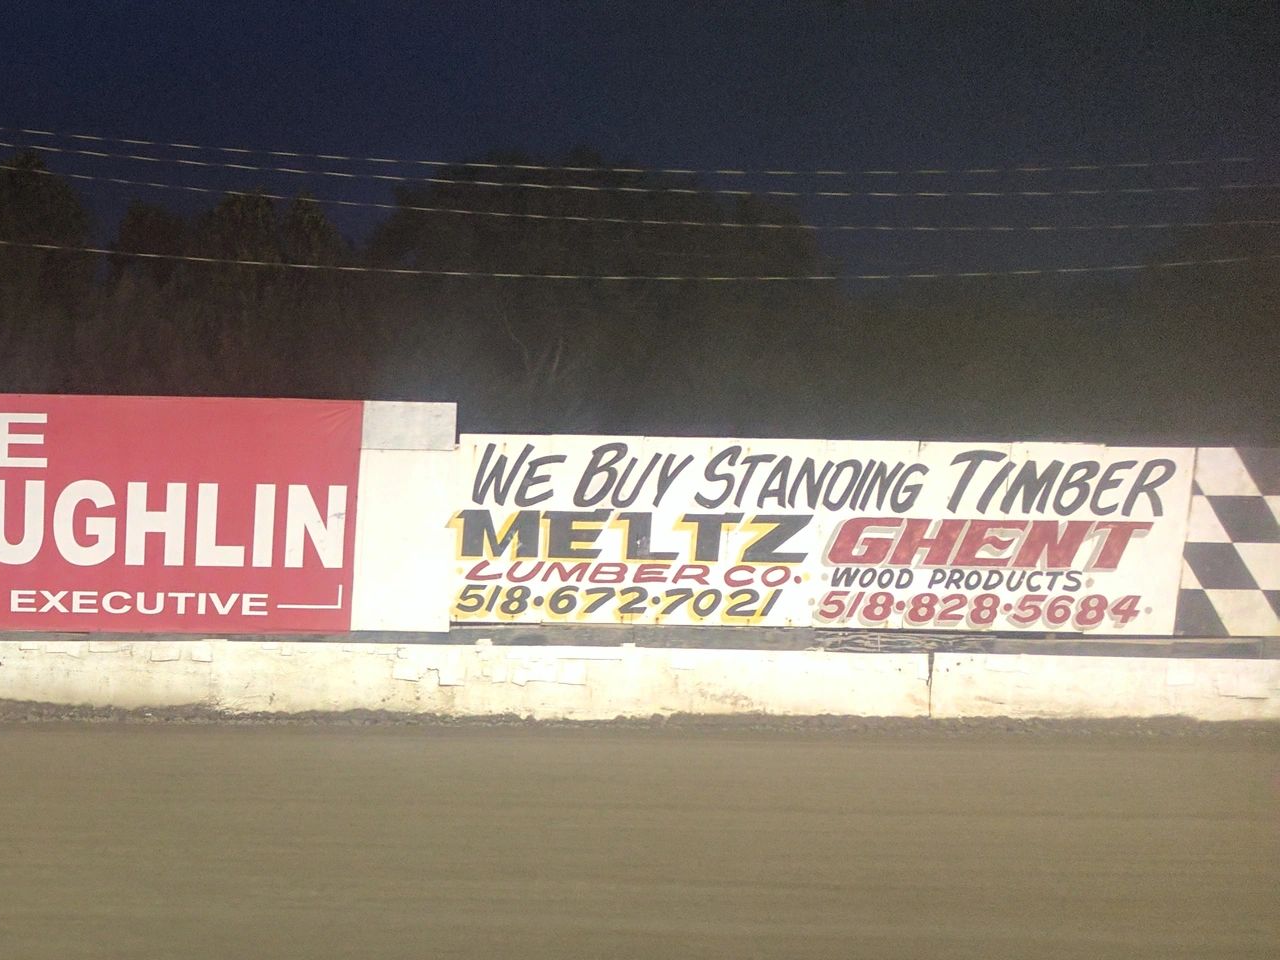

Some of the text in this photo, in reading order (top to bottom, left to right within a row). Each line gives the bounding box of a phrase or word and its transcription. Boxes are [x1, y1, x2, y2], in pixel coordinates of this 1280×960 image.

[471, 442, 1177, 517] WE BUY STANDING TIMBER
[451, 508, 814, 564] MELTZ
[824, 517, 1154, 570] GHENT
[465, 559, 803, 588] LUMBER CO.
[830, 567, 1083, 592] WOOD PRODUCTS
[10, 589, 269, 616] EXECUTIVE
